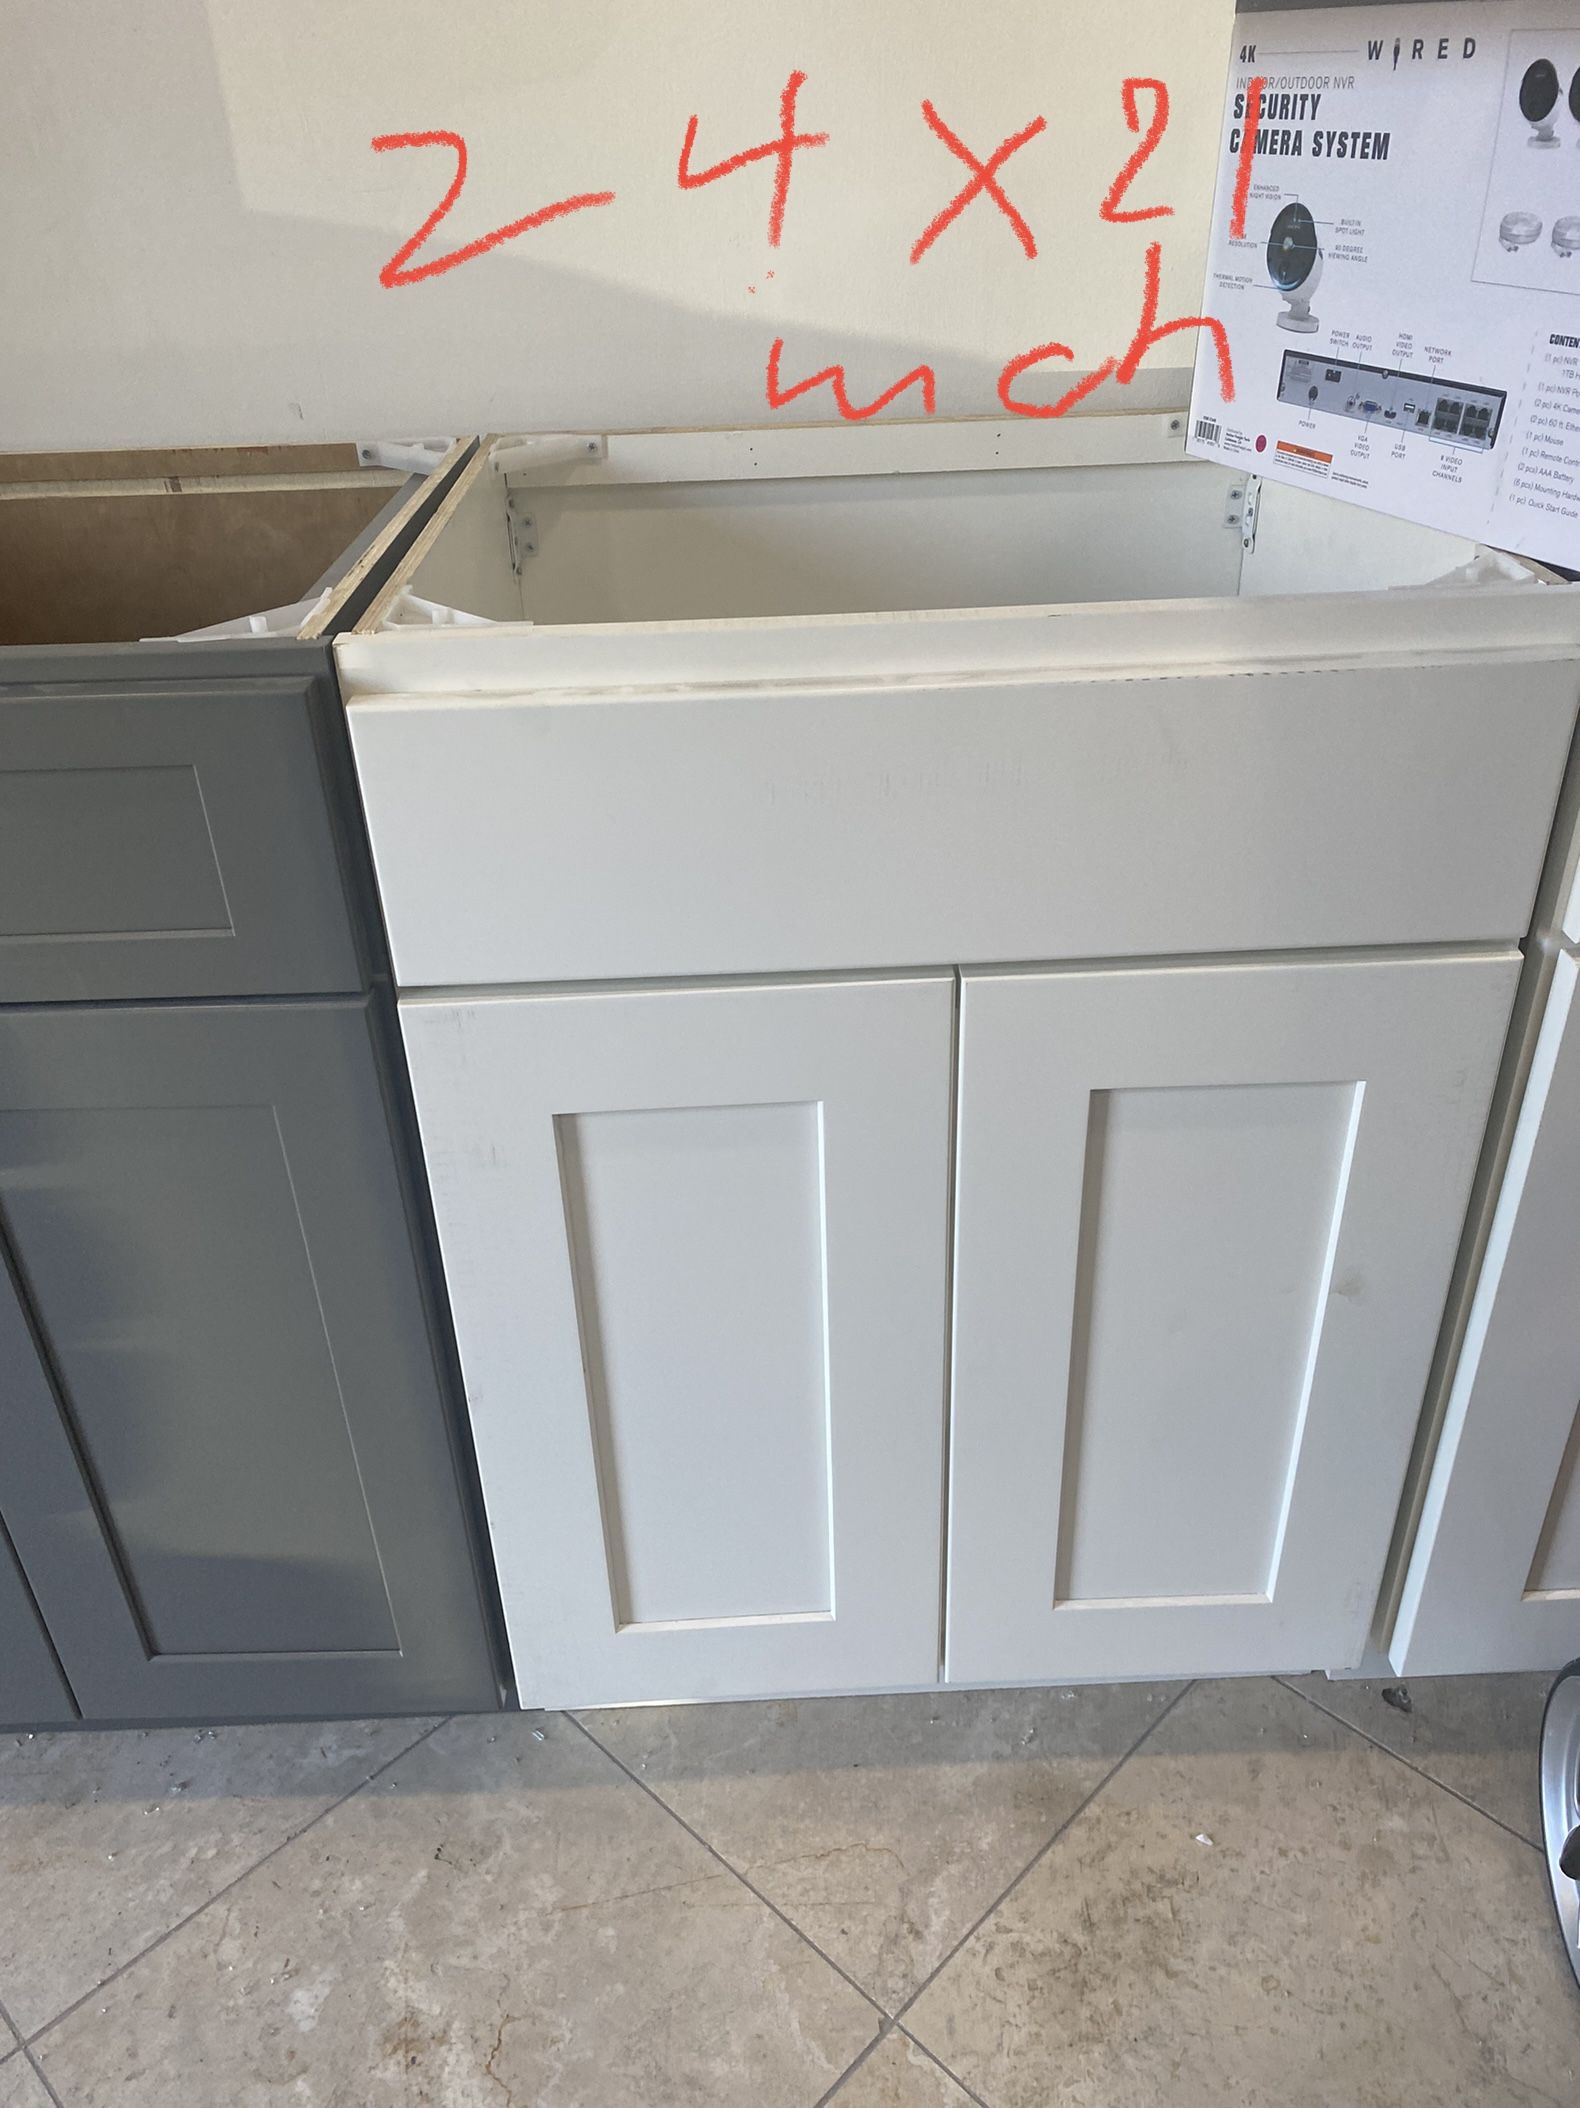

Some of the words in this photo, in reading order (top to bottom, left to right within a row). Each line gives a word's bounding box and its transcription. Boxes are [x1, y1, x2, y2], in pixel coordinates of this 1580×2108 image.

[1239, 45, 1256, 63] 4K
[1333, 76, 1355, 89] NVR
[1229, 128, 1303, 156] CMERA
[1312, 130, 1391, 160] SYSTEM
[1228, 240, 1258, 249] RESOLUTION
[1331, 329, 1350, 338] POWER
[1356, 334, 1373, 343] AUDIO
[1330, 337, 1349, 347] SWITCH
[1352, 342, 1373, 351] OUTPUT
[1396, 341, 1413, 350] VIDEO
[1392, 349, 1413, 359] OUTPUT
[1424, 346, 1452, 357] NETWORK
[1428, 355, 1444, 364] PORT
[1564, 356, 1578, 366] NVR
[1298, 420, 1316, 429] POWER
[1357, 435, 1368, 443] VGA
[1545, 435, 1564, 446] Mouse
[1354, 443, 1370, 451] VIDEO
[1394, 443, 1406, 452] USB
[1350, 450, 1370, 460] OUTPUT
[1391, 451, 1406, 459] PORT
[1540, 450, 1562, 462] Remote
[1445, 456, 1463, 466] VIDEO
[1440, 464, 1458, 473] INPUT
[1432, 470, 1462, 484] CHANNELS
[1539, 467, 1552, 476] AAA
[1553, 470, 1574, 484] Battery
[1535, 483, 1561, 499] Mounting
[1528, 498, 1544, 509] Quick
[1545, 503, 1560, 513] Start
[1560, 507, 1579, 519] Guide
